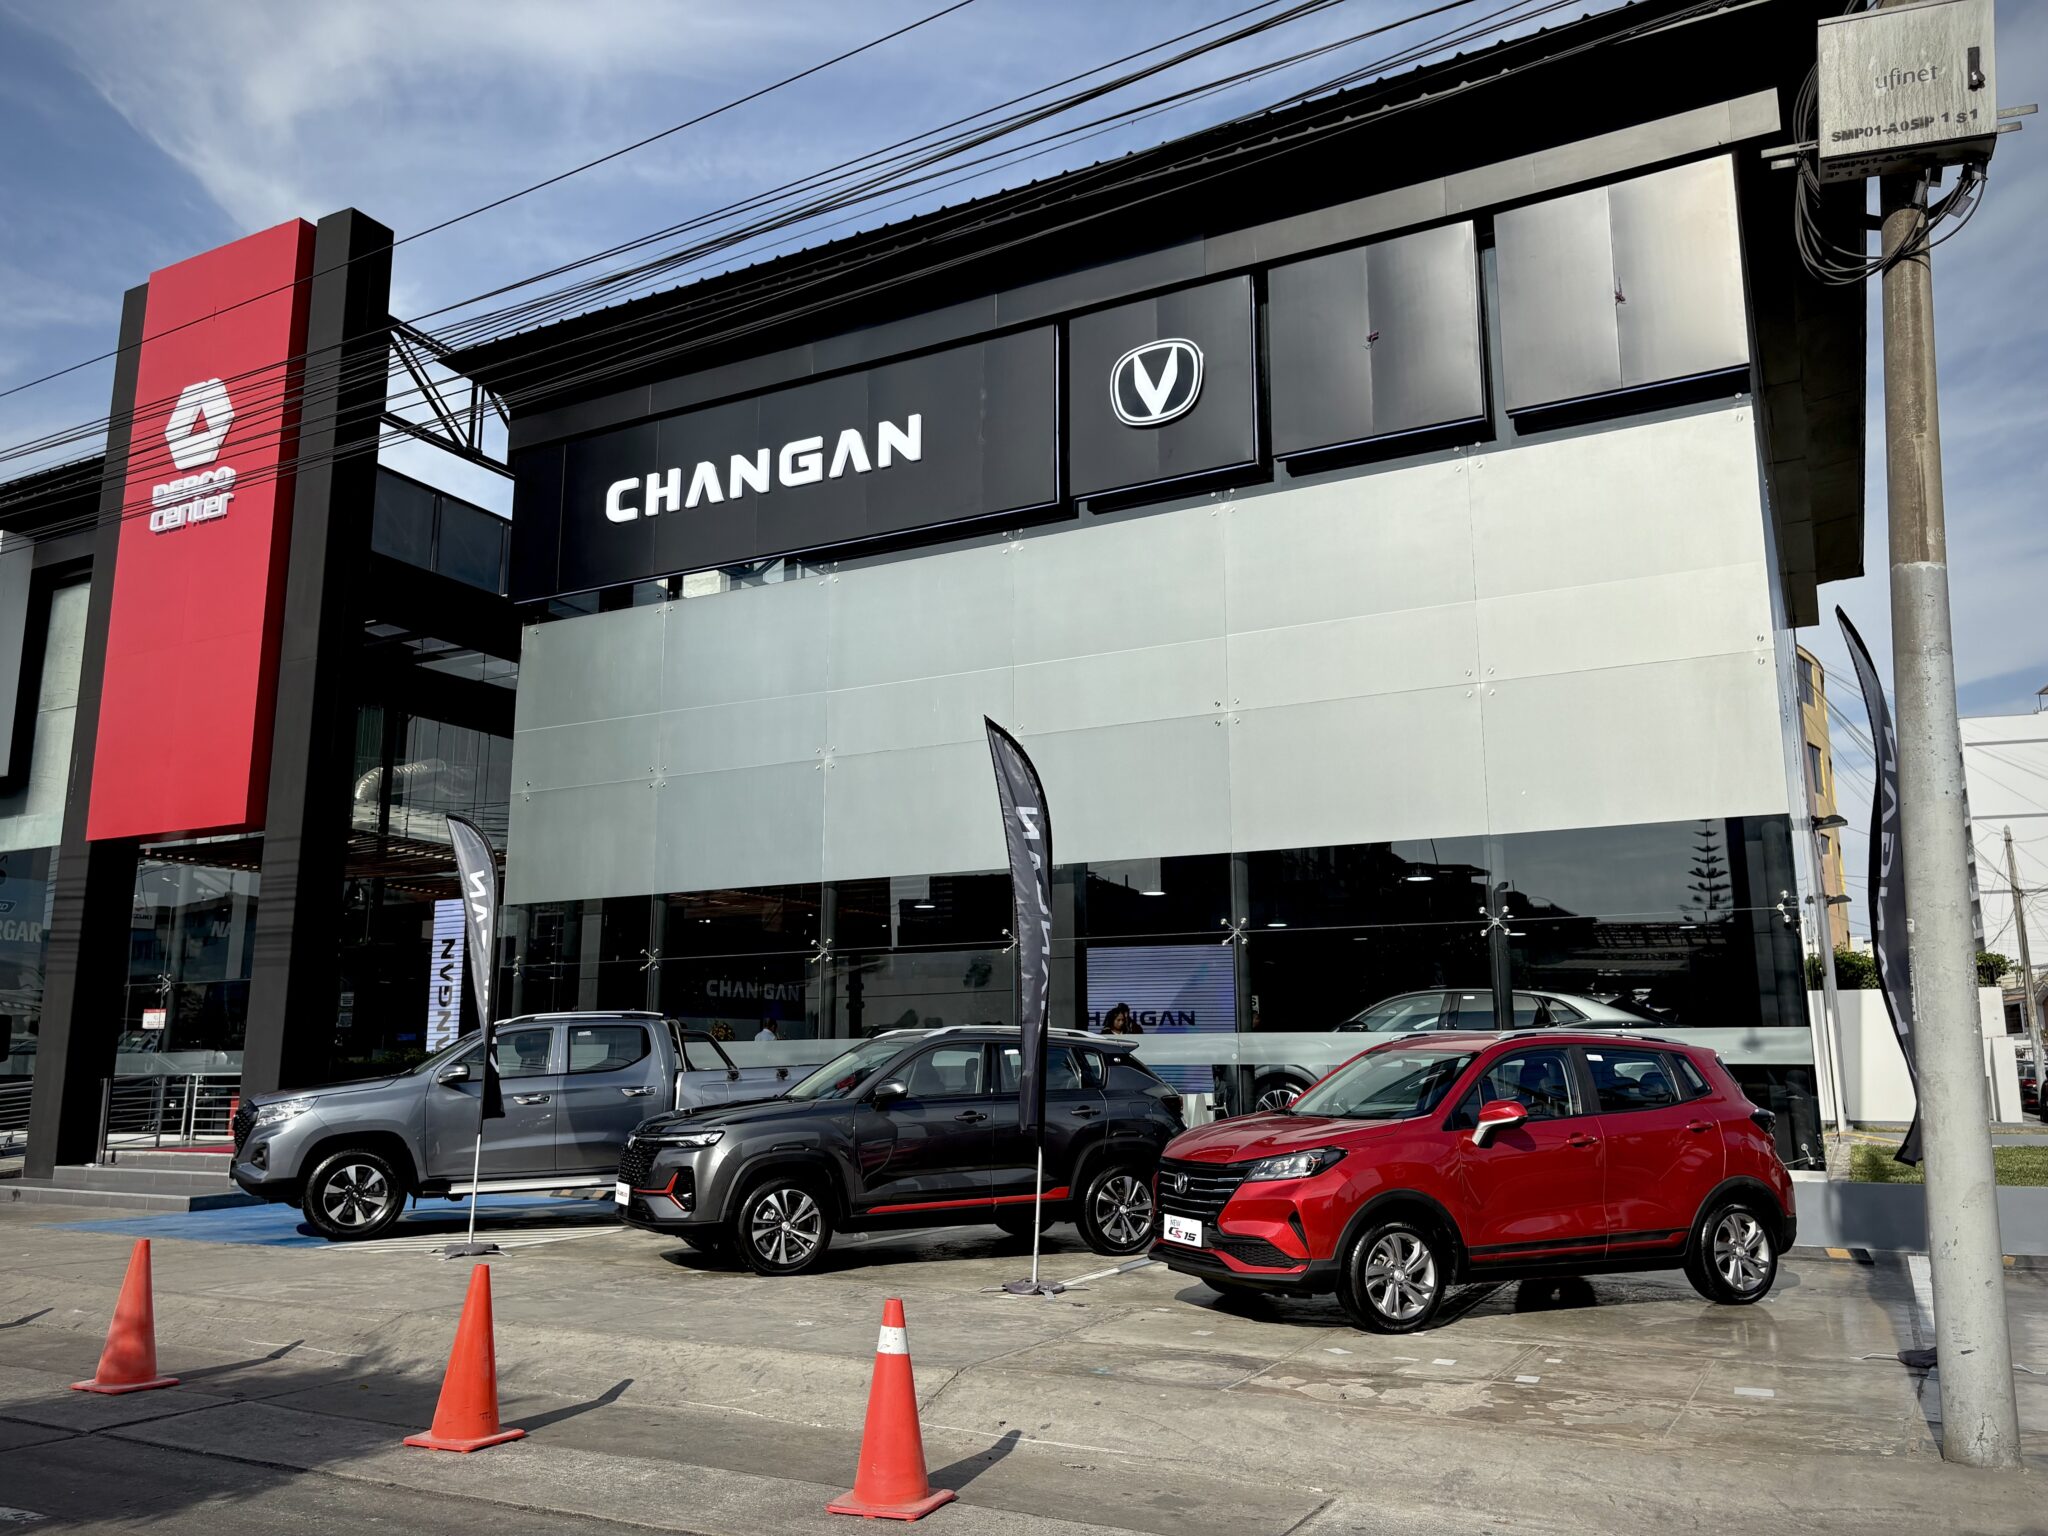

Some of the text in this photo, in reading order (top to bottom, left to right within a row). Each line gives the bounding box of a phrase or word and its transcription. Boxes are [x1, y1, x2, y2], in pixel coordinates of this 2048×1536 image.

[1874, 64, 1938, 91] ufinet
[605, 413, 922, 523] CHANGAN
[149, 492, 234, 533] center
[706, 979, 800, 1001] CHANGAN
[1088, 1010, 1196, 1027] HGAN
